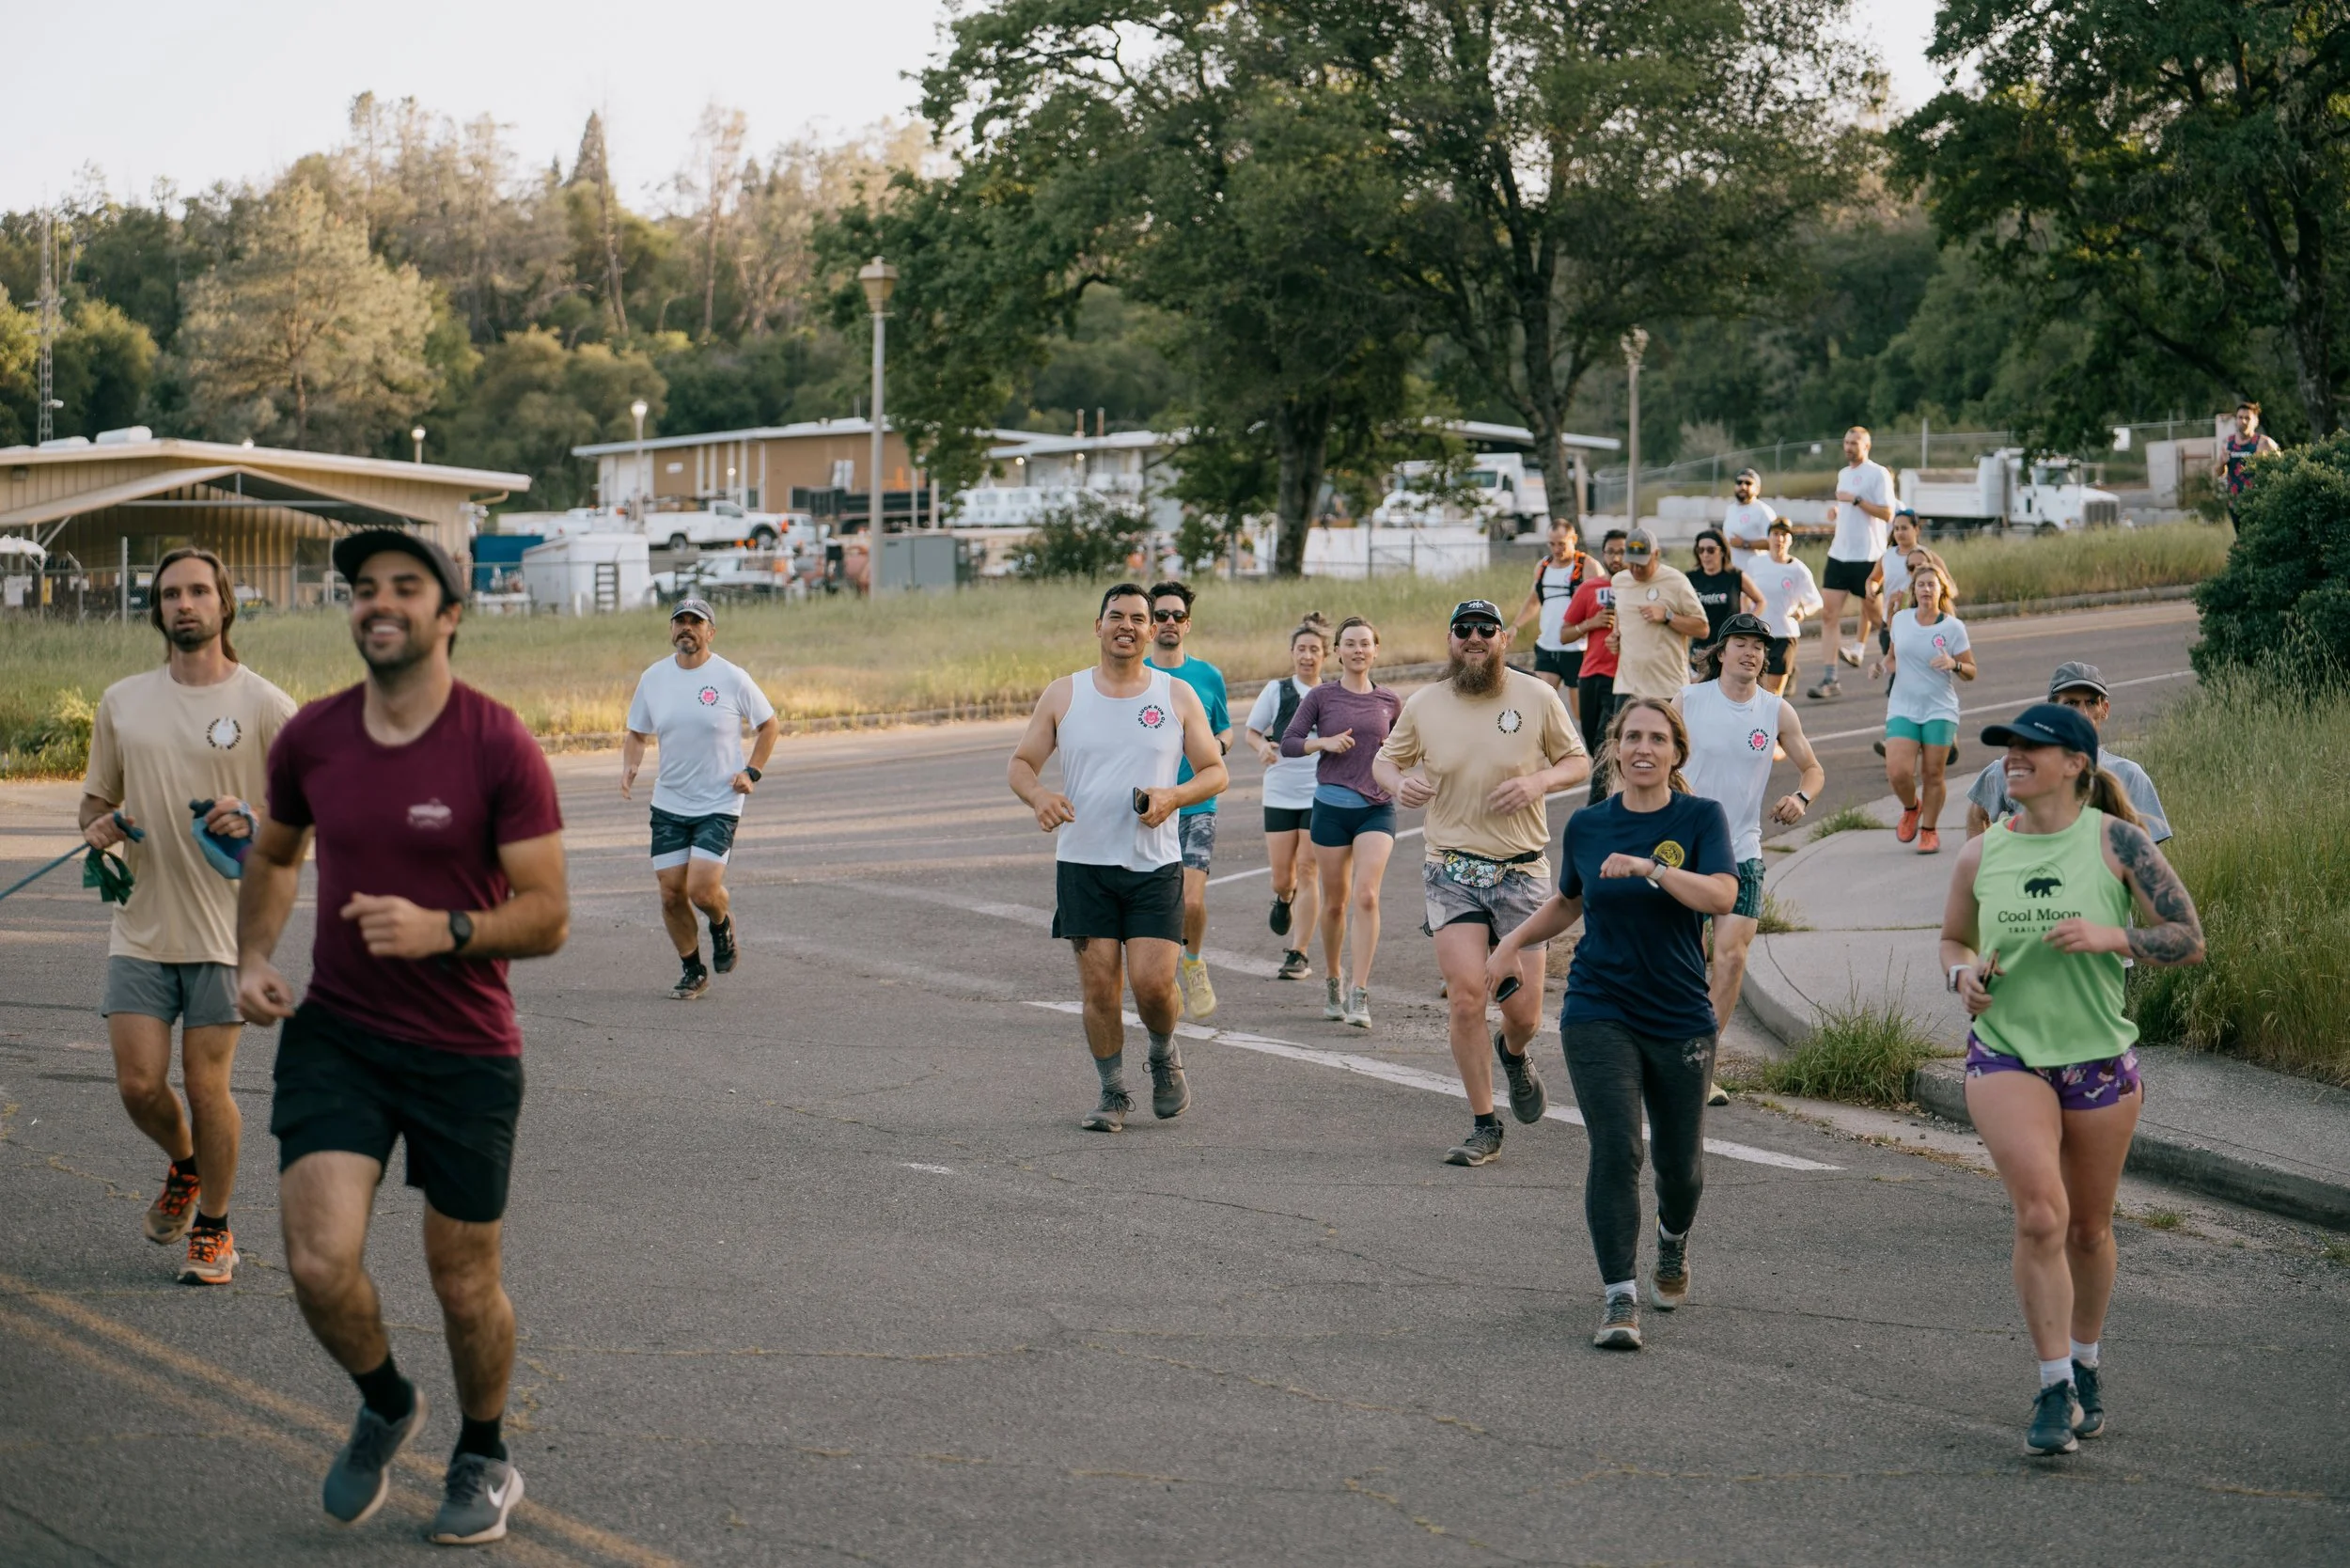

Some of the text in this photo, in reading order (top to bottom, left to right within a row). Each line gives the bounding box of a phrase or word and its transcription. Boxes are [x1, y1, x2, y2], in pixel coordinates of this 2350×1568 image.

[1138, 704, 1152, 717] LUCK
[1153, 705, 1165, 716] RUN
[1154, 716, 1166, 729] CLUB
[1998, 908, 2031, 923] Cool
[2008, 925, 2036, 933] TRAIL
